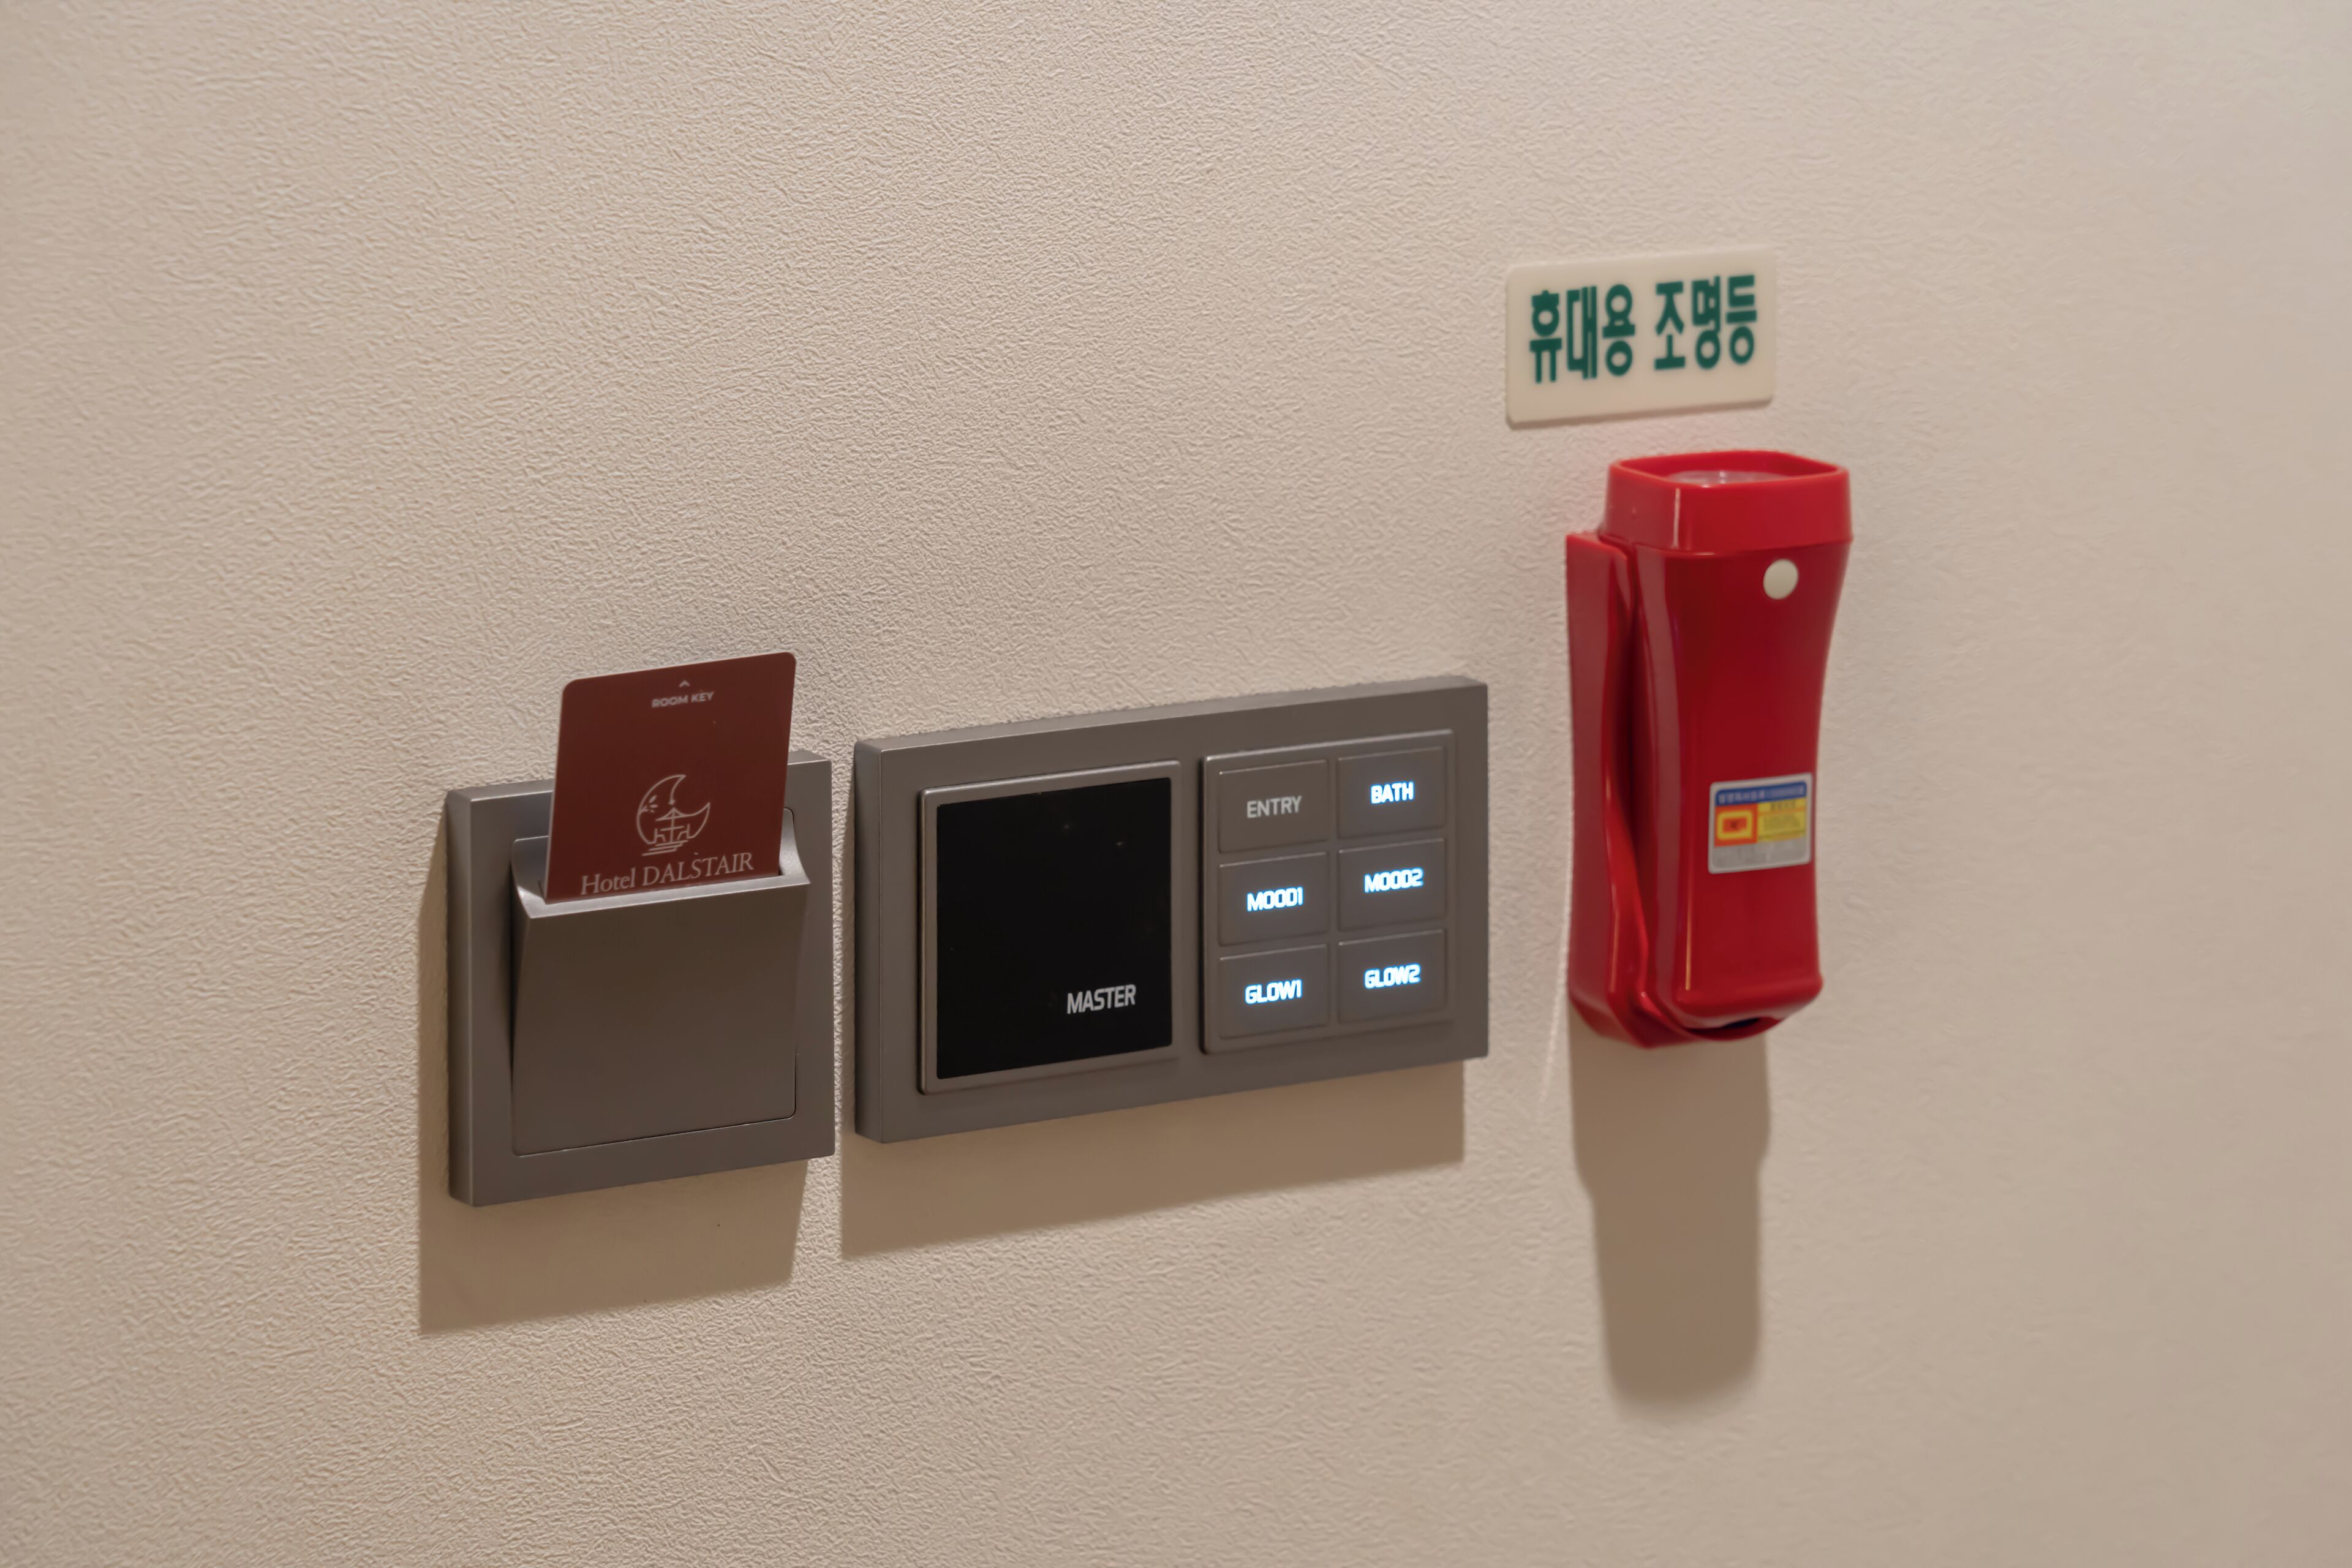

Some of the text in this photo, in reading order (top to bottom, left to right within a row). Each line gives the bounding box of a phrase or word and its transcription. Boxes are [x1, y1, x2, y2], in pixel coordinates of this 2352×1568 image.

[1529, 274, 1757, 384] 휴대용 조명등
[652, 691, 714, 708] ROOM KEY
[1370, 782, 1415, 804] BATH
[1246, 796, 1302, 818] ENTRY
[580, 853, 754, 895] Hotel DALSTAIR
[1364, 868, 1424, 893] MOOD2
[1246, 887, 1303, 911] MOOD1
[1364, 963, 1421, 989] GLOW2
[1066, 984, 1136, 1014] MASTER
[1245, 979, 1302, 1005] GLOW1
